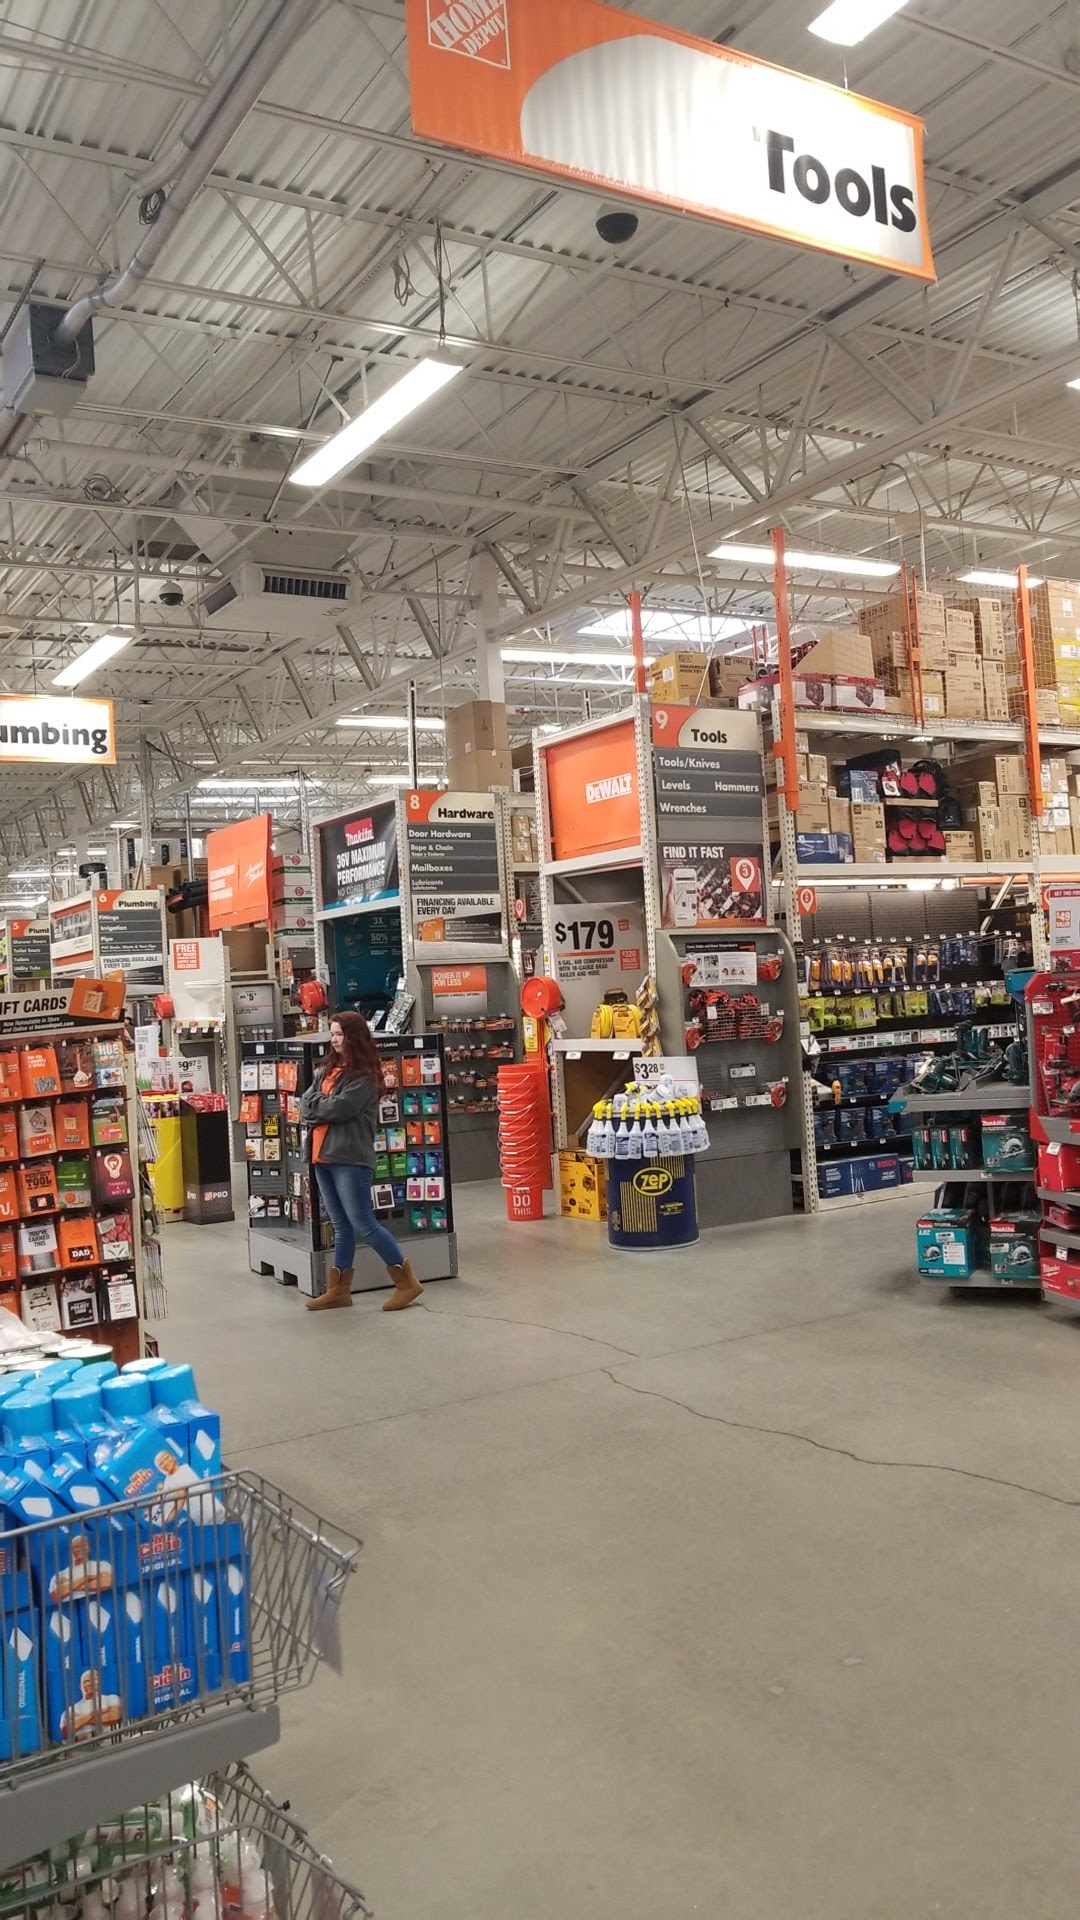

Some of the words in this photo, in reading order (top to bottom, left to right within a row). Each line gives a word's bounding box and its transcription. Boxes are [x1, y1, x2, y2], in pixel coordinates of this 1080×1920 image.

[461, 12, 506, 55] DEPOT
[753, 126, 917, 233] Tools
[655, 710, 668, 730] 9
[690, 728, 728, 744] Tools
[658, 756, 721, 770] Tools/Knives
[662, 780, 690, 791] Levels
[714, 781, 760, 793] Hammers
[410, 794, 420, 810] 8
[660, 802, 708, 814] Wrenches
[438, 808, 494, 819] Hardware
[408, 830, 428, 838] Door
[430, 830, 472, 838] Hardware
[336, 850, 350, 869] 36V
[350, 840, 386, 866] MAXIMUM
[663, 846, 686, 858] FIND
[688, 846, 698, 858] IT
[700, 846, 724, 858] FAST
[337, 859, 386, 886] PERFORMANCE
[412, 863, 453, 872] Mailboxes
[742, 868, 748, 876] 3
[338, 887, 346, 898] NO
[365, 877, 386, 890] NEEDED
[99, 892, 108, 902] 6
[416, 898, 456, 906] FINANCING
[457, 898, 494, 906] AVAILABLE
[118, 900, 158, 908] Plumbing
[418, 906, 440, 915] EVERY
[442, 906, 456, 914] DAY
[1056, 912, 1070, 922] $49
[554, 920, 614, 950] $179
[176, 944, 196, 952] FREE
[433, 972, 454, 980] POWER
[23, 996, 68, 1013] CARDS
[100, 1044, 118, 1054] HUE
[635, 1063, 658, 1080] $328
[32, 1138, 50, 1146] SWEET
[877, 1160, 896, 1168] BOSCH
[26, 1176, 52, 1188] TOOL
[513, 1194, 530, 1207] DO
[514, 1207, 534, 1216] THIS.
[28, 1228, 48, 1236] YOU'VE
[28, 1234, 50, 1243] EARNED
[72, 1249, 90, 1258] DAD
[138, 1538, 181, 1558] Cean
[149, 1667, 190, 1689] Clen
[154, 1689, 191, 1704] RIGAL
